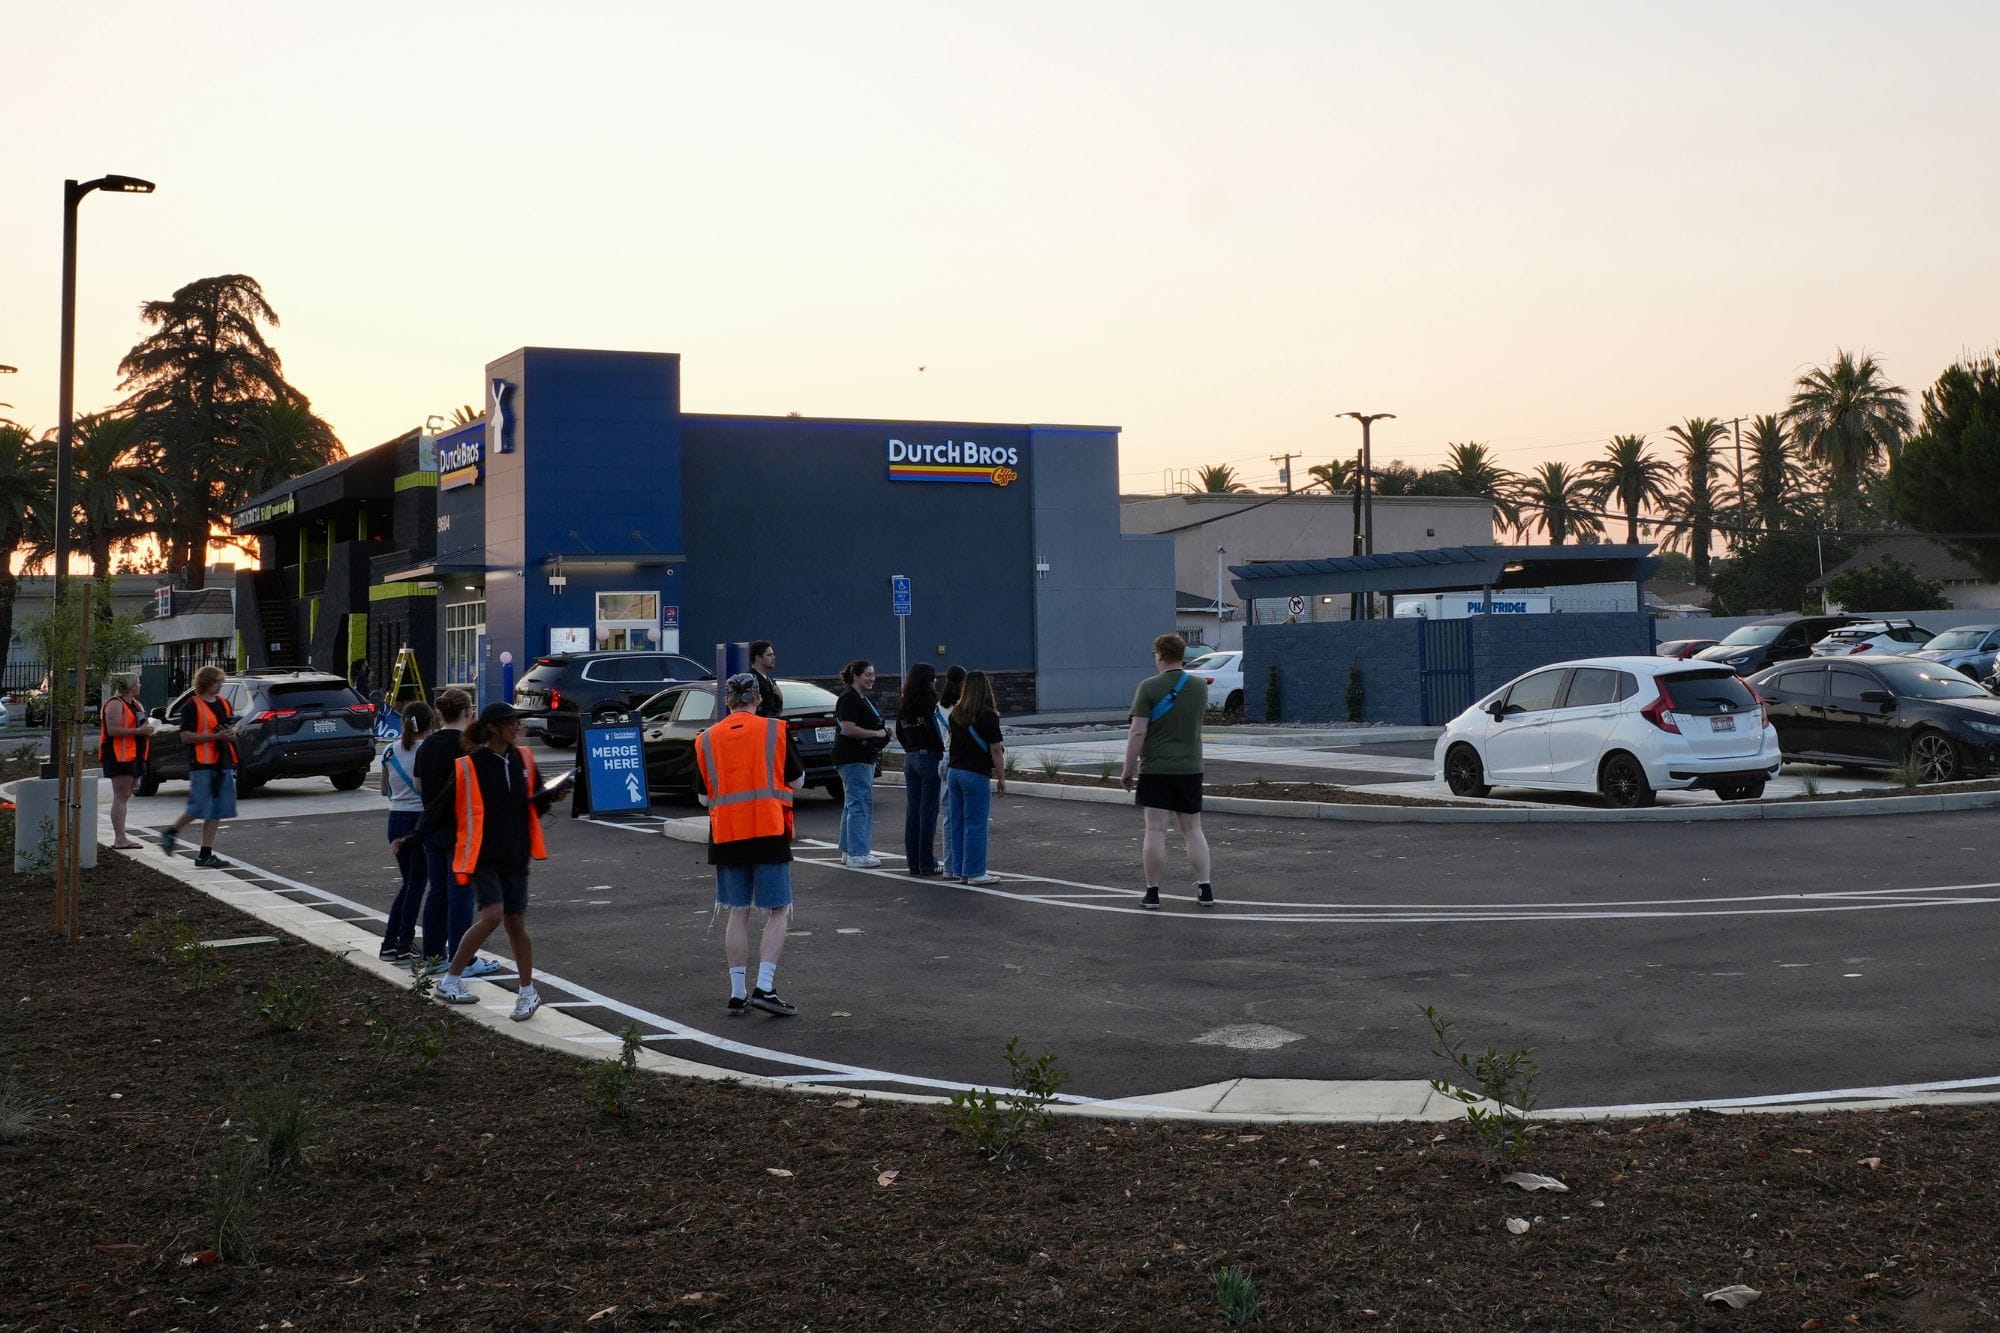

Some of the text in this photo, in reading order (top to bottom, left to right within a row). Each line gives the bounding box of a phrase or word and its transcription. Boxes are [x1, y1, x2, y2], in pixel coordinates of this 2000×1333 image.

[963, 441, 1019, 466] BROS
[992, 466, 1017, 485] Coffee
[592, 745, 639, 758] MERGE
[603, 758, 640, 770] HERE
